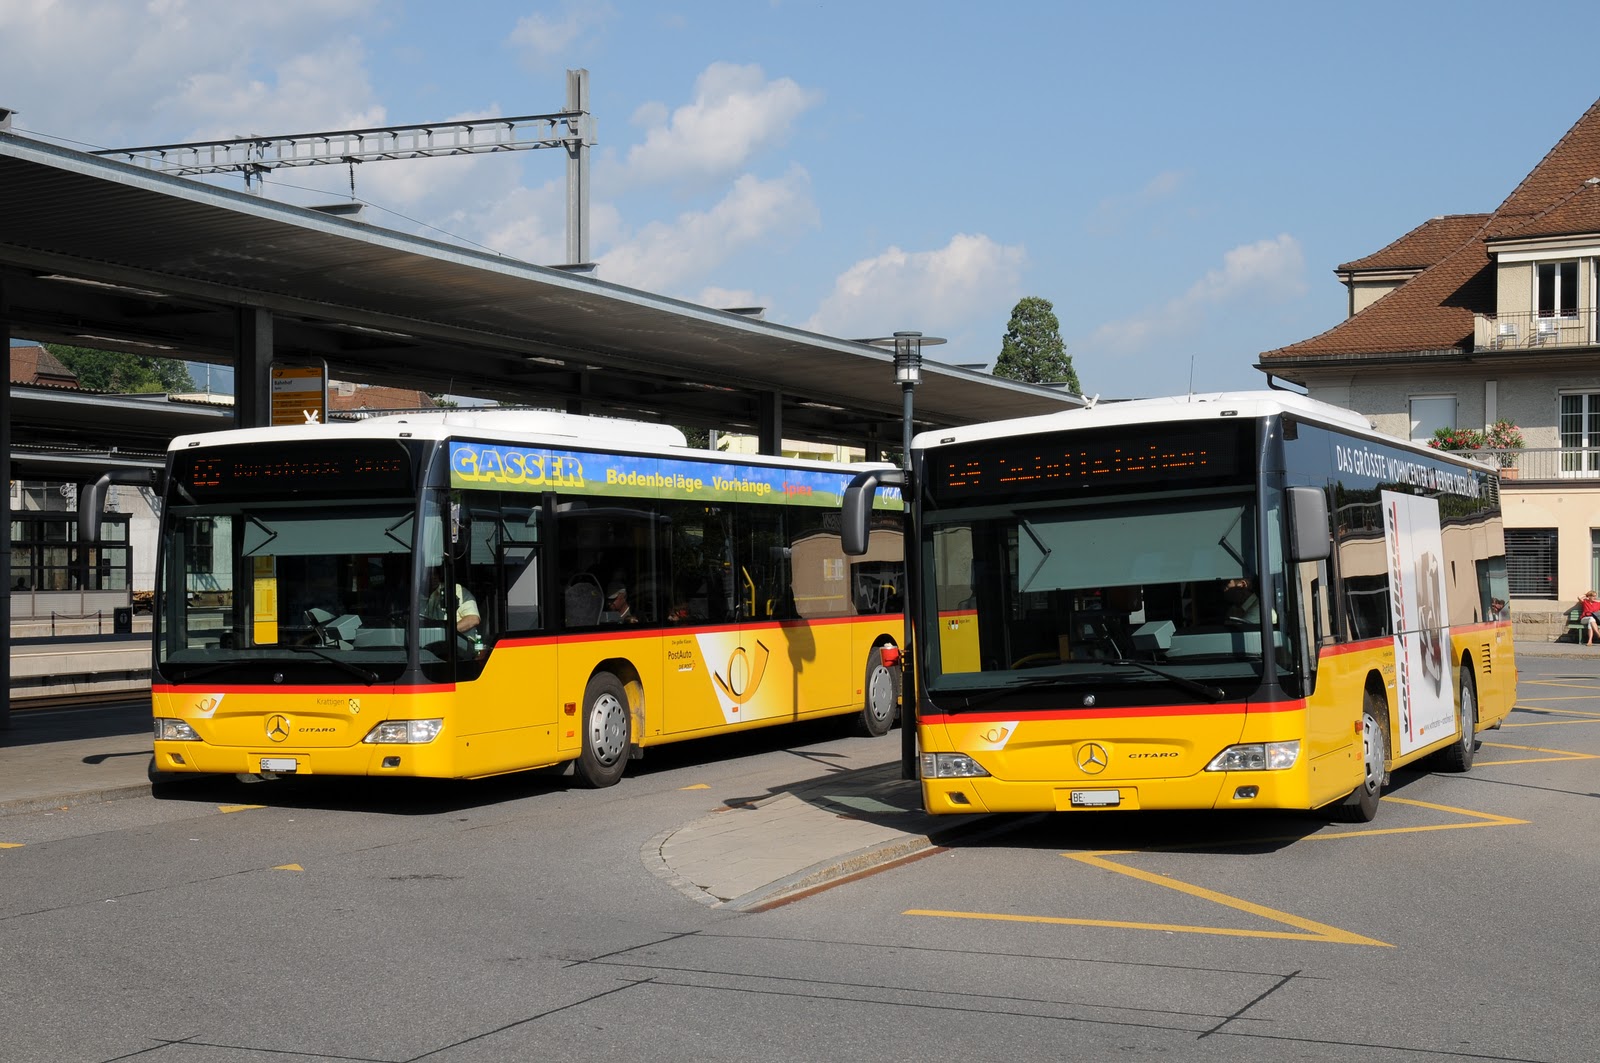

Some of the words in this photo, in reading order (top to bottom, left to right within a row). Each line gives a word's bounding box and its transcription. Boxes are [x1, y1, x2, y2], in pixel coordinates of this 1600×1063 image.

[452, 447, 585, 488] GASSER
[1336, 445, 1352, 473] DAS
[1353, 447, 1386, 479] GRÖSSTE
[1387, 458, 1427, 487] WOHNCENTER
[1435, 470, 1453, 493] BERNER
[606, 468, 703, 493] Bodenbeläge
[712, 476, 771, 497] Vorhänge
[782, 480, 813, 499] Spiez
[667, 650, 692, 660] PostAuto
[316, 697, 345, 706] Krattigen
